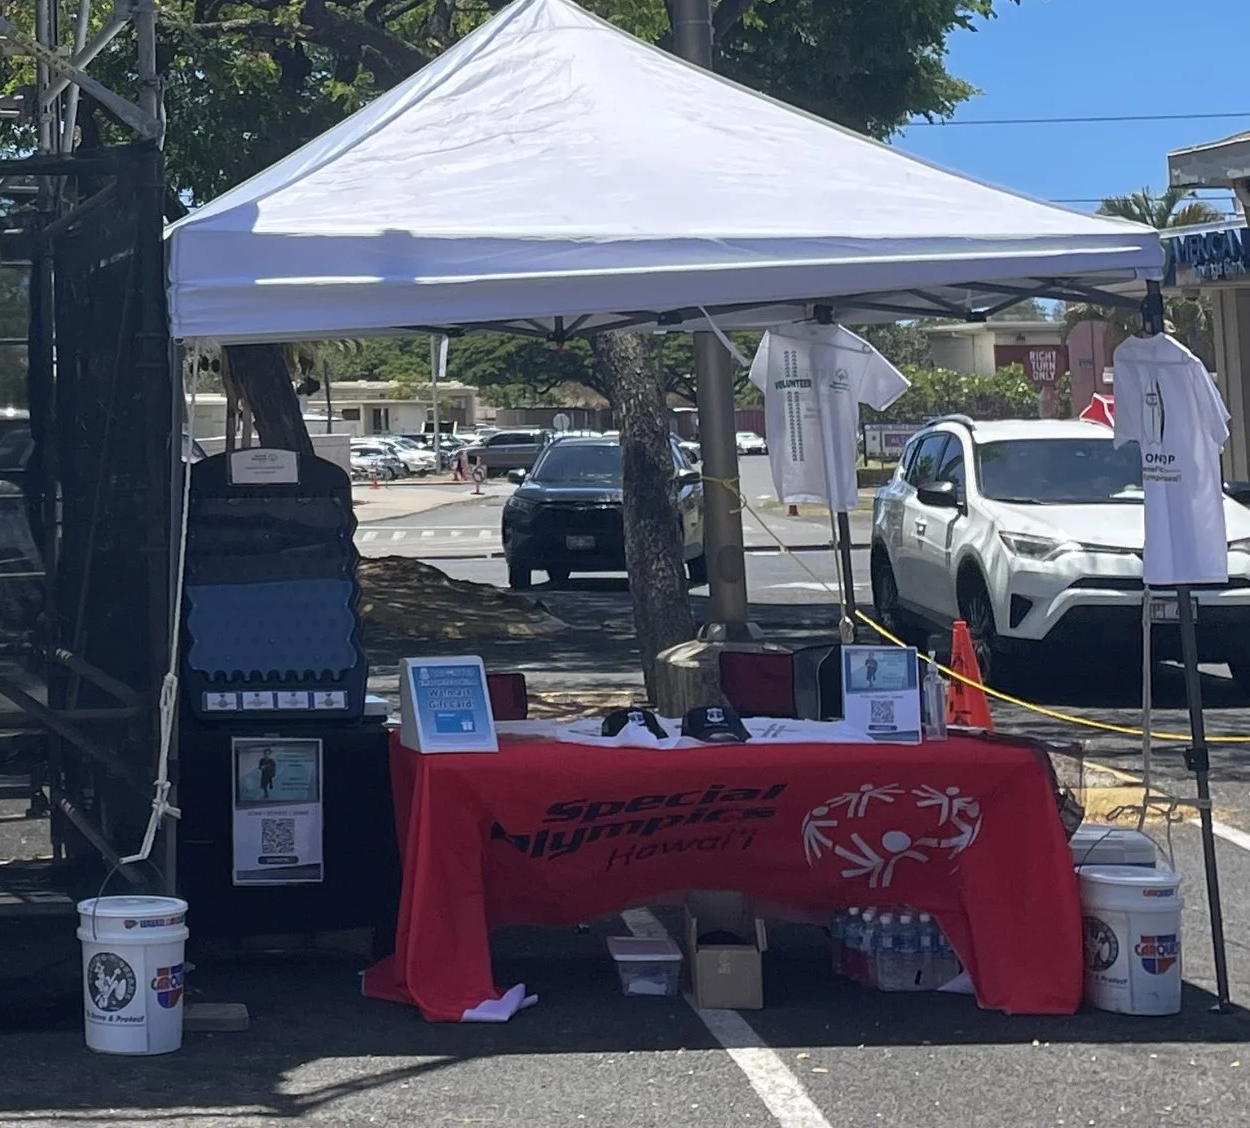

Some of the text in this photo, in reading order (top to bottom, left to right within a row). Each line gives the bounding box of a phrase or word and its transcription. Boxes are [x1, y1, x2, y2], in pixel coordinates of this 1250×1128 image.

[1029, 351, 1057, 361] RIGHT
[1031, 361, 1056, 371] TURN
[1033, 371, 1056, 381] ONLY
[543, 784, 788, 823] Special
